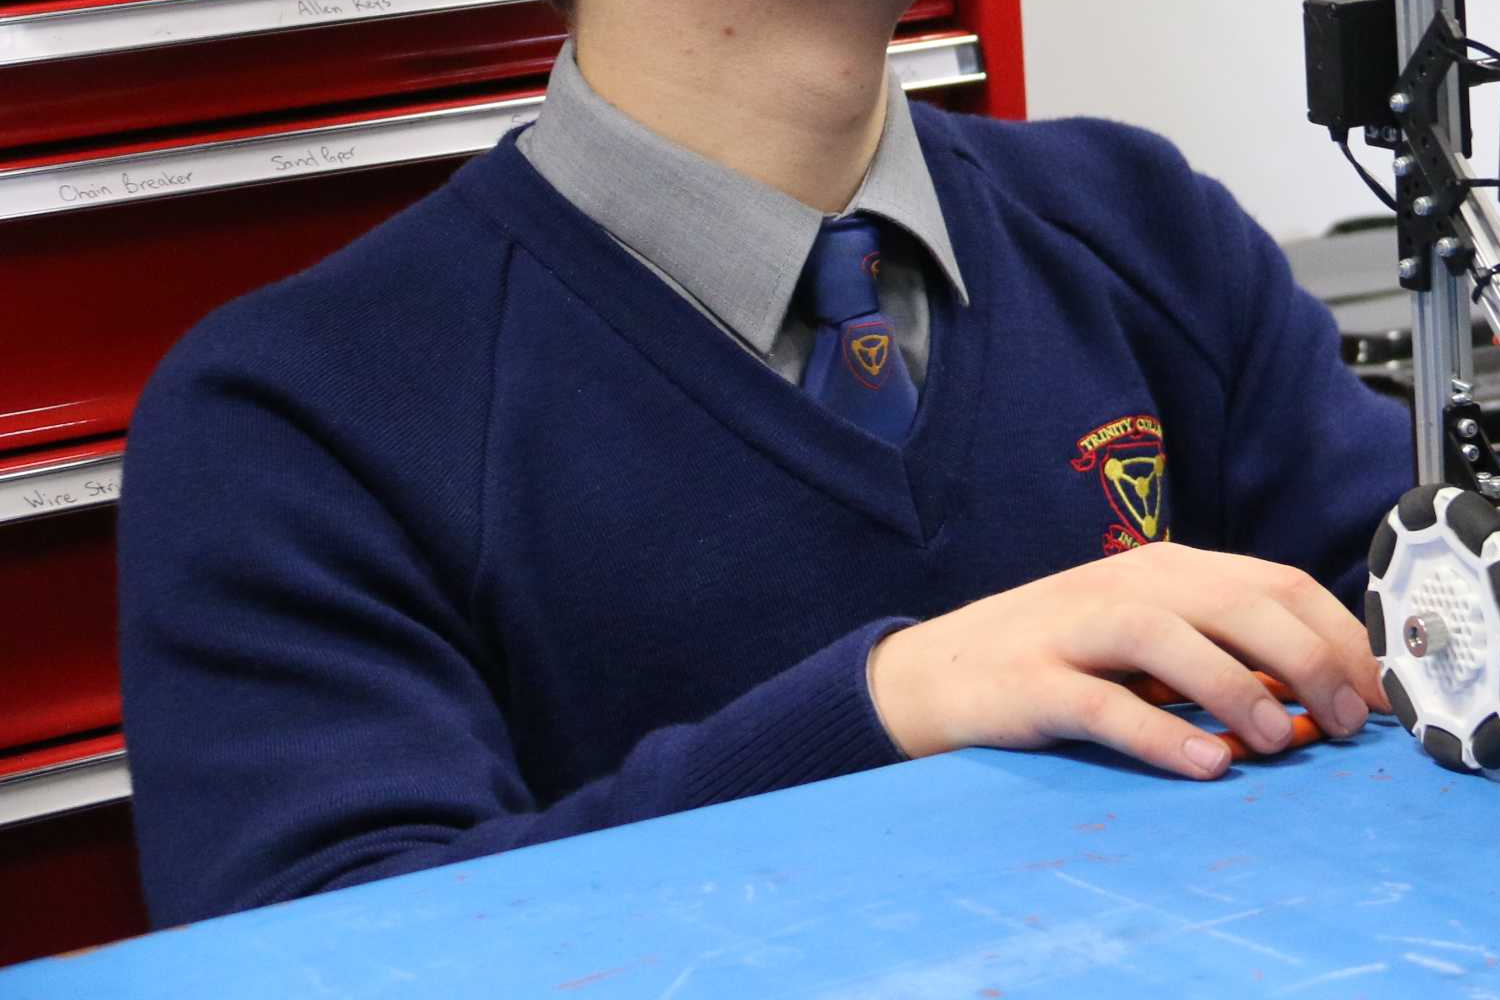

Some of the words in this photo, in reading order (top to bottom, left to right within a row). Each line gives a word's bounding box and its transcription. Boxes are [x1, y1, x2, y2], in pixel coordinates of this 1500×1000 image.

[297, 0, 344, 16] Allen
[58, 183, 113, 203] Chain
[121, 171, 194, 195] Breaker
[270, 149, 319, 172] Sand
[1080, 417, 1132, 450] TRINITY
[23, 488, 78, 508] Wire
